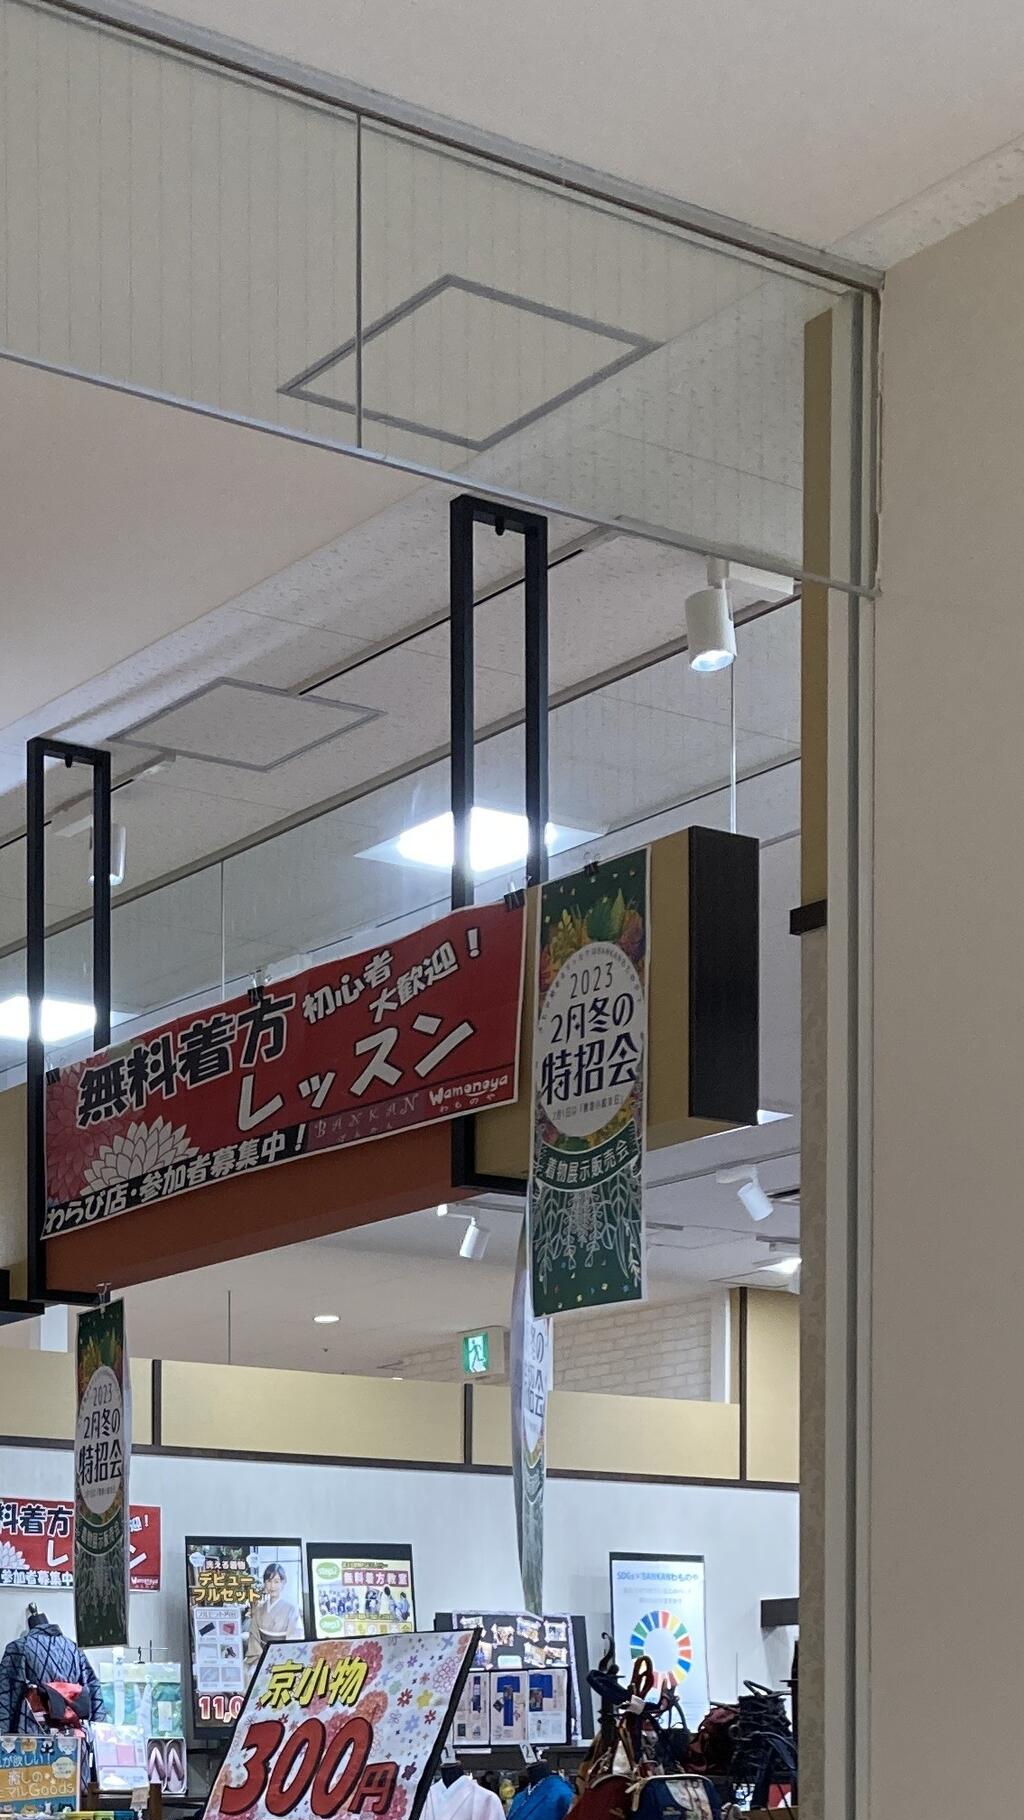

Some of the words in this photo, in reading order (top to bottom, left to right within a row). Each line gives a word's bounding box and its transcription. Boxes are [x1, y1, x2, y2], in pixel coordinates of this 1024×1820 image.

[303, 950, 393, 1023] 初心者
[369, 927, 482, 1023] 大歓迎！
[570, 962, 613, 999] 2023
[551, 993, 634, 1044] 2月冬の
[77, 992, 296, 1130] 無料着方
[236, 1013, 475, 1133] レッスン
[541, 1032, 638, 1105] 特招会
[314, 1092, 420, 1138] BANKAN
[428, 1075, 509, 1106] Wamonoya
[46, 1122, 308, 1235] わらび店・参加者募集中！
[545, 1139, 630, 1184] 着物展示販売会
[93, 1383, 113, 1407] 2023
[83, 1407, 121, 1440] 2月冬の
[79, 1439, 123, 1486] 特招会
[193, 1588, 262, 1603] フルセット
[199, 1572, 254, 1587] デビュー
[259, 1656, 370, 1709] 京小物
[218, 1716, 401, 1819] 300円
